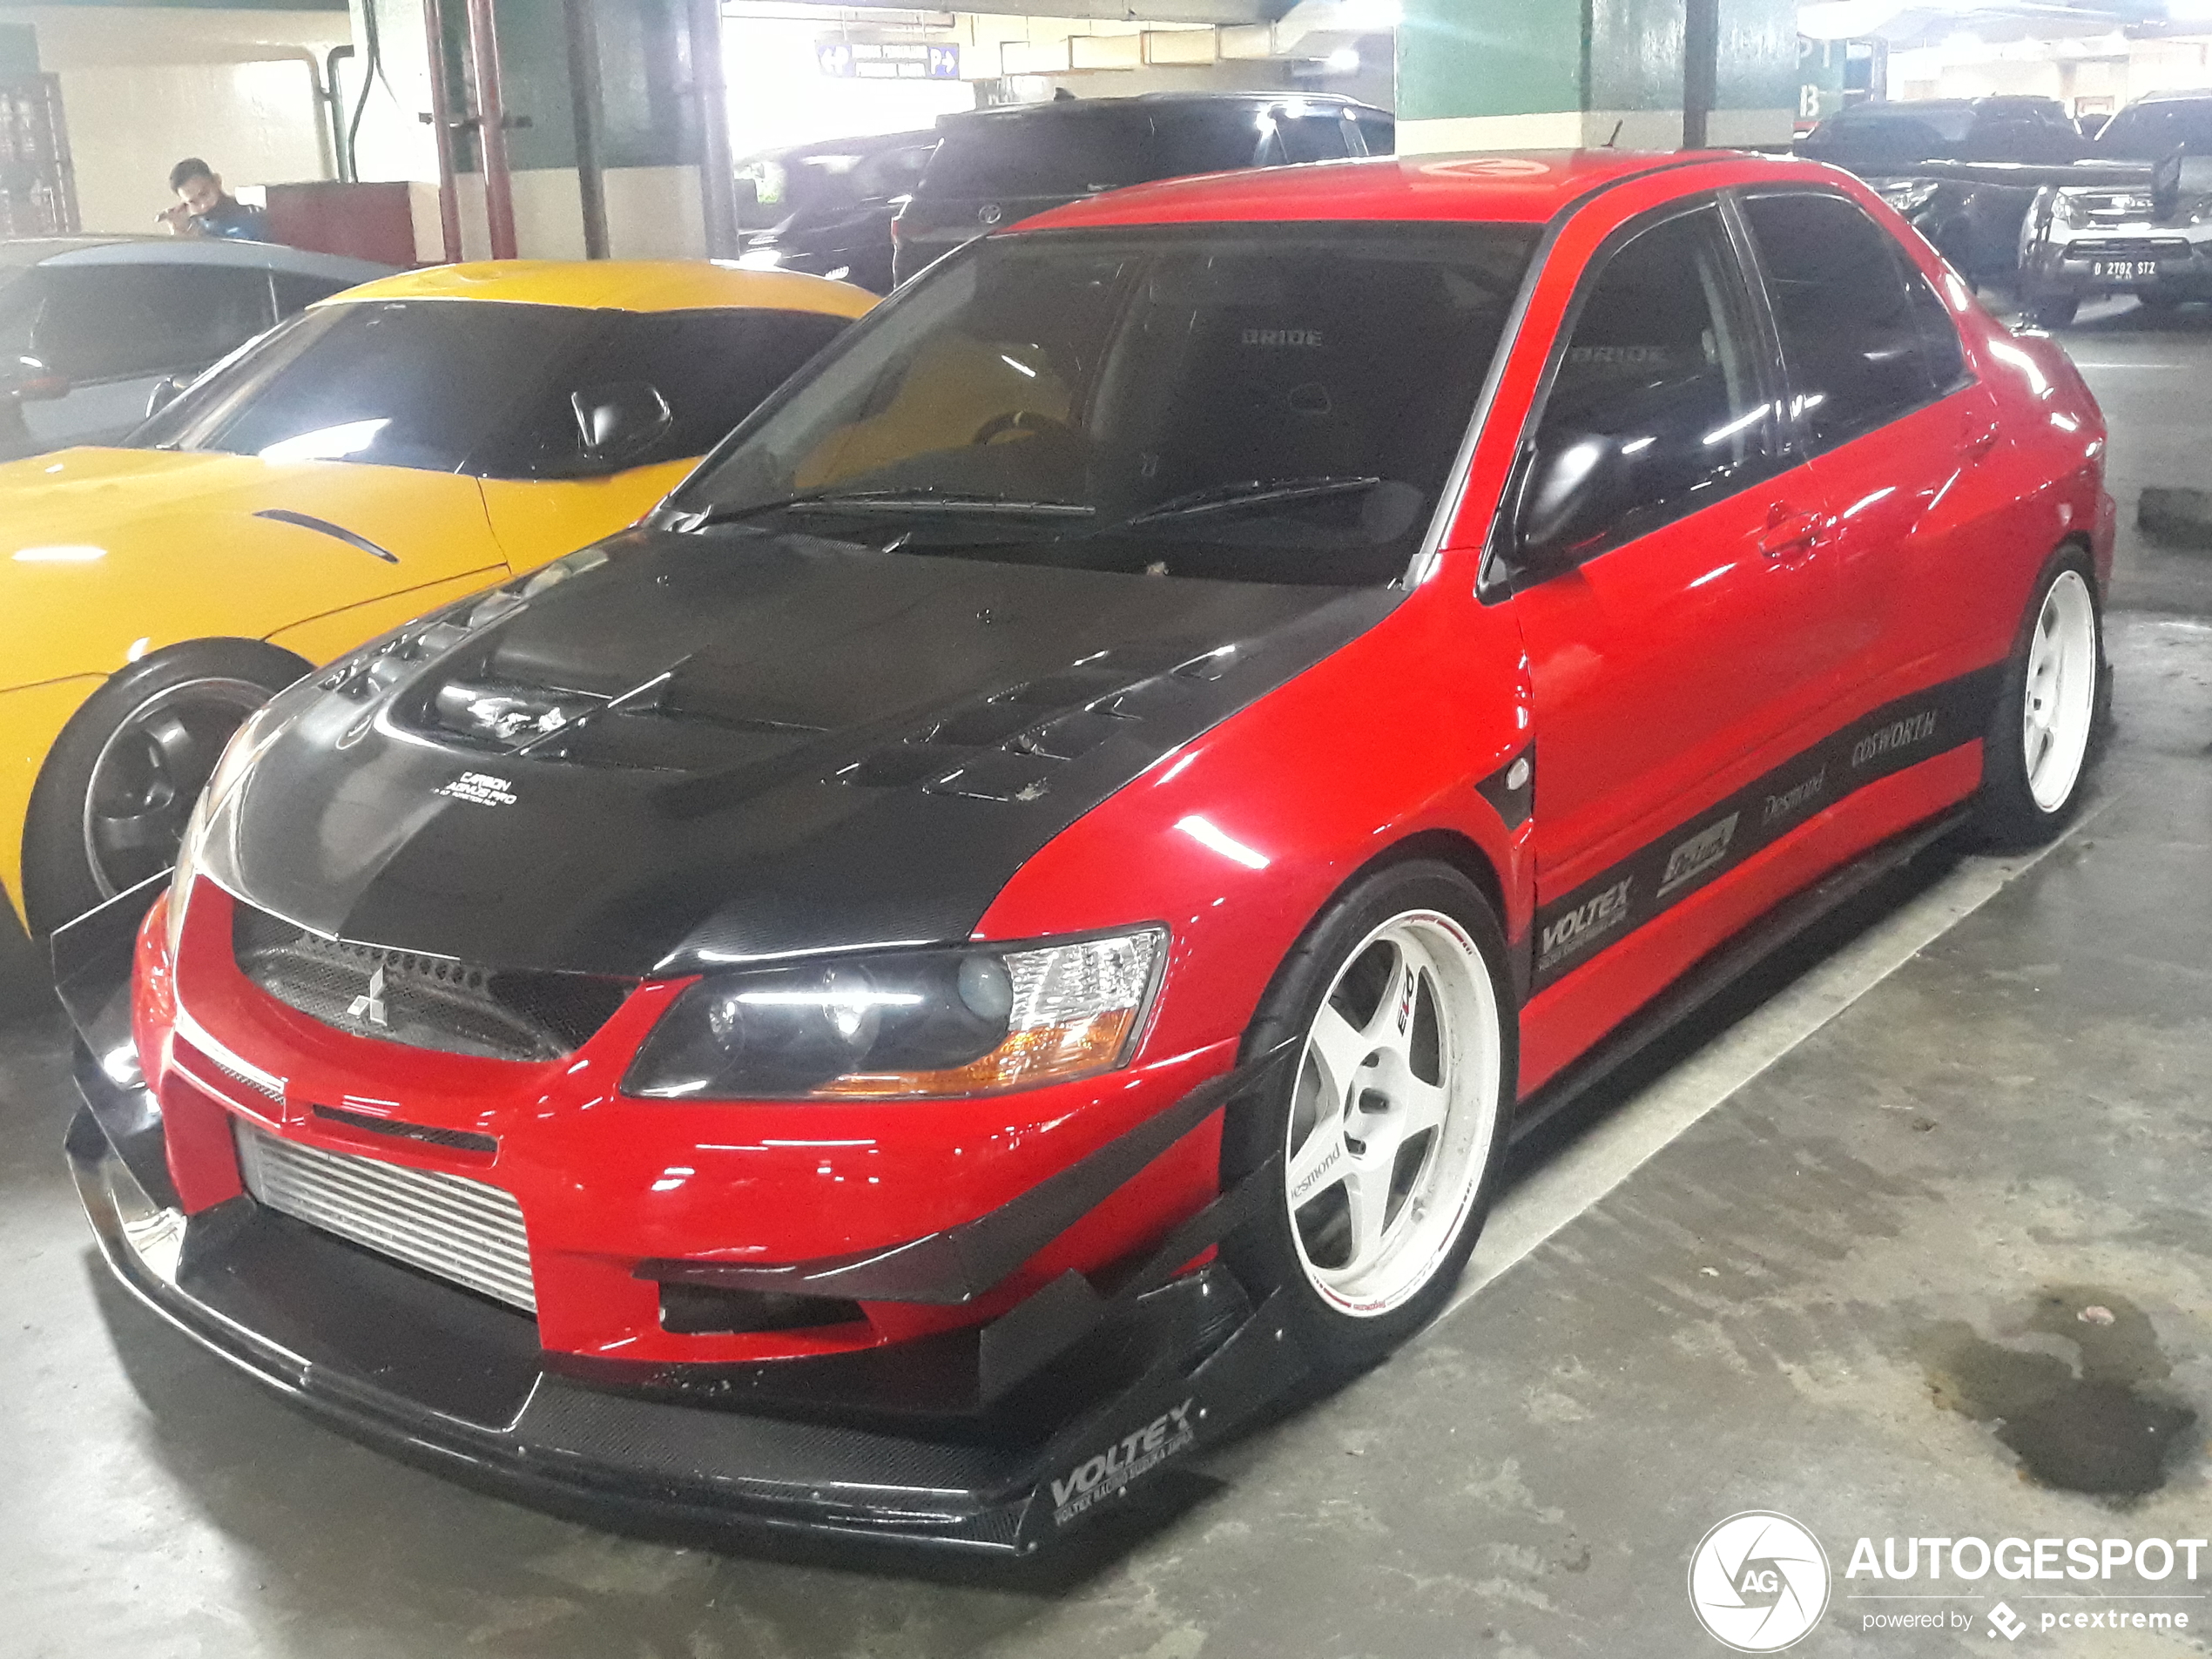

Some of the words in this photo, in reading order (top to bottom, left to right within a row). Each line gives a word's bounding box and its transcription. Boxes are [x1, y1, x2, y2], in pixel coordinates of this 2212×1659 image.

[1800, 84, 1819, 117] B
[1852, 710, 1937, 767] COSWORTH
[460, 772, 512, 792] CARBON
[1543, 874, 1634, 954] VOLTEX
[1291, 1142, 1340, 1200] esmond
[1050, 1397, 1193, 1508] VOLTEX
